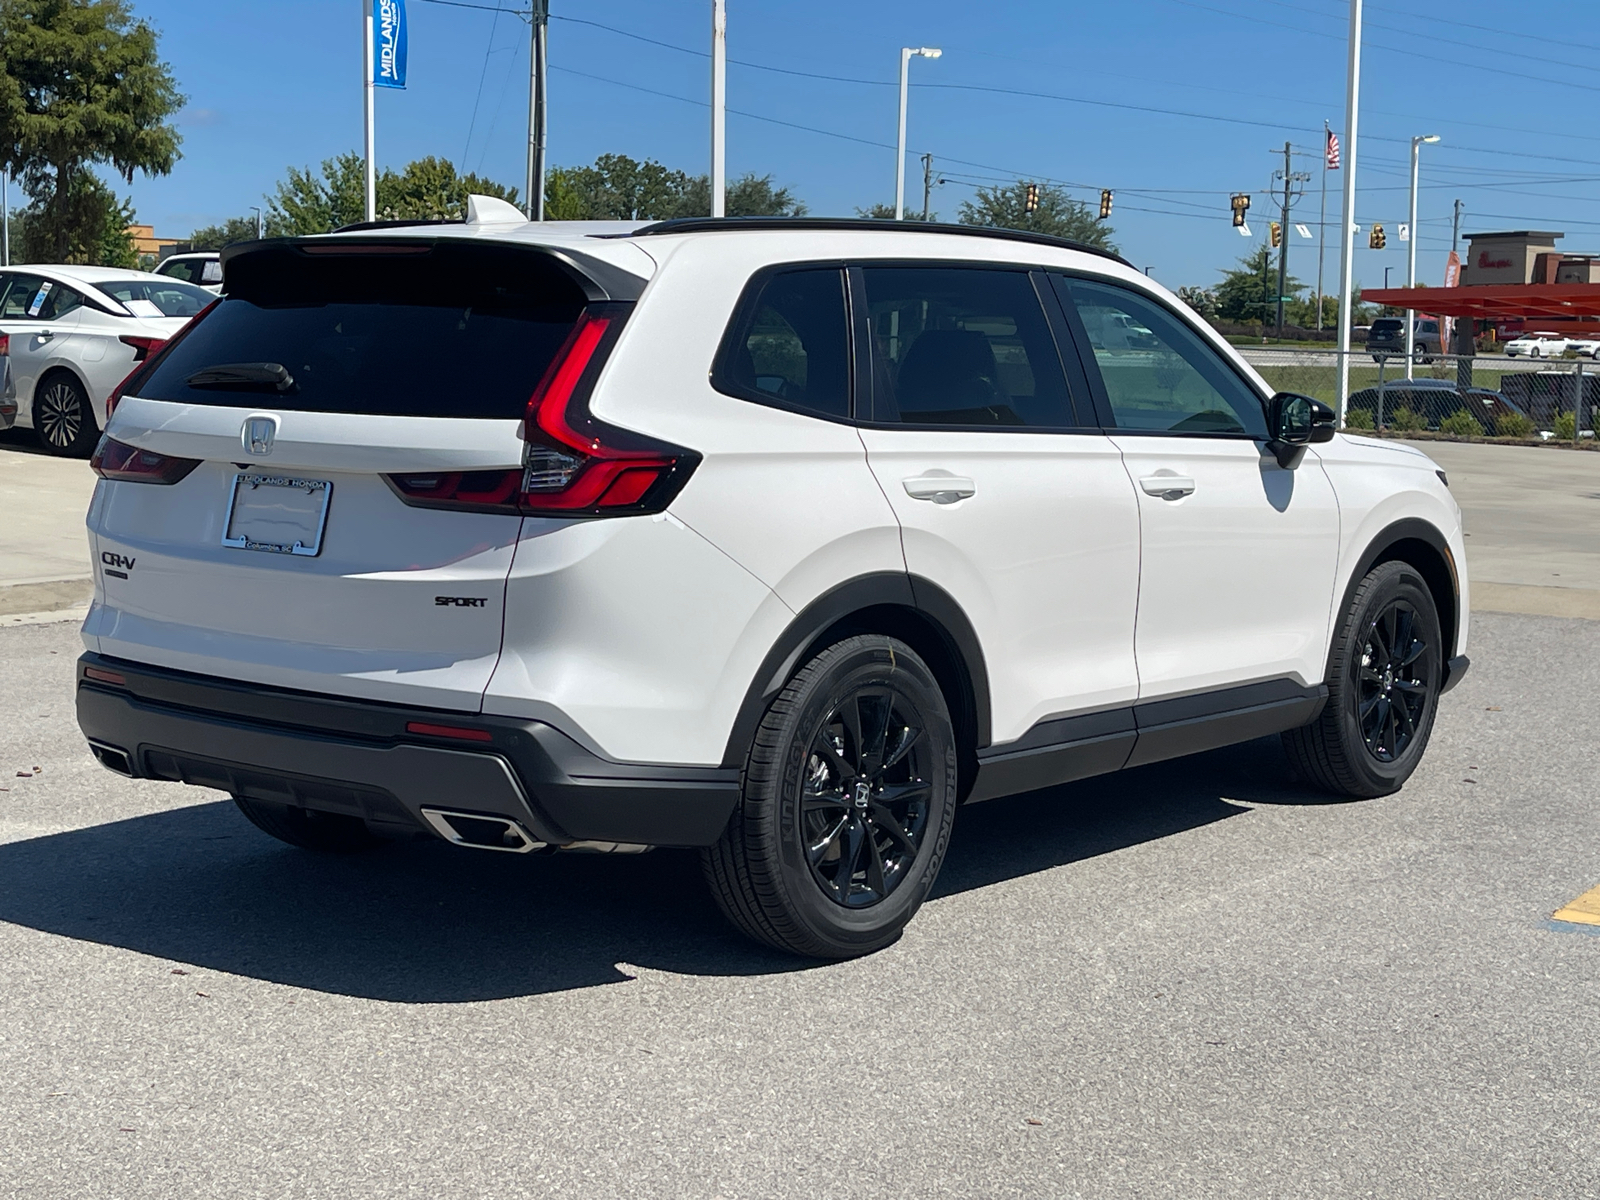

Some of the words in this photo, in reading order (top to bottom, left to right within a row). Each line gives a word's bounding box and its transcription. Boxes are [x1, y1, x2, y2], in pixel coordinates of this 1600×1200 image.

[245, 475, 289, 486] MIDLANDS
[292, 480, 325, 489] HONDA
[102, 551, 136, 570] CR-V
[435, 596, 488, 607] SPORT
